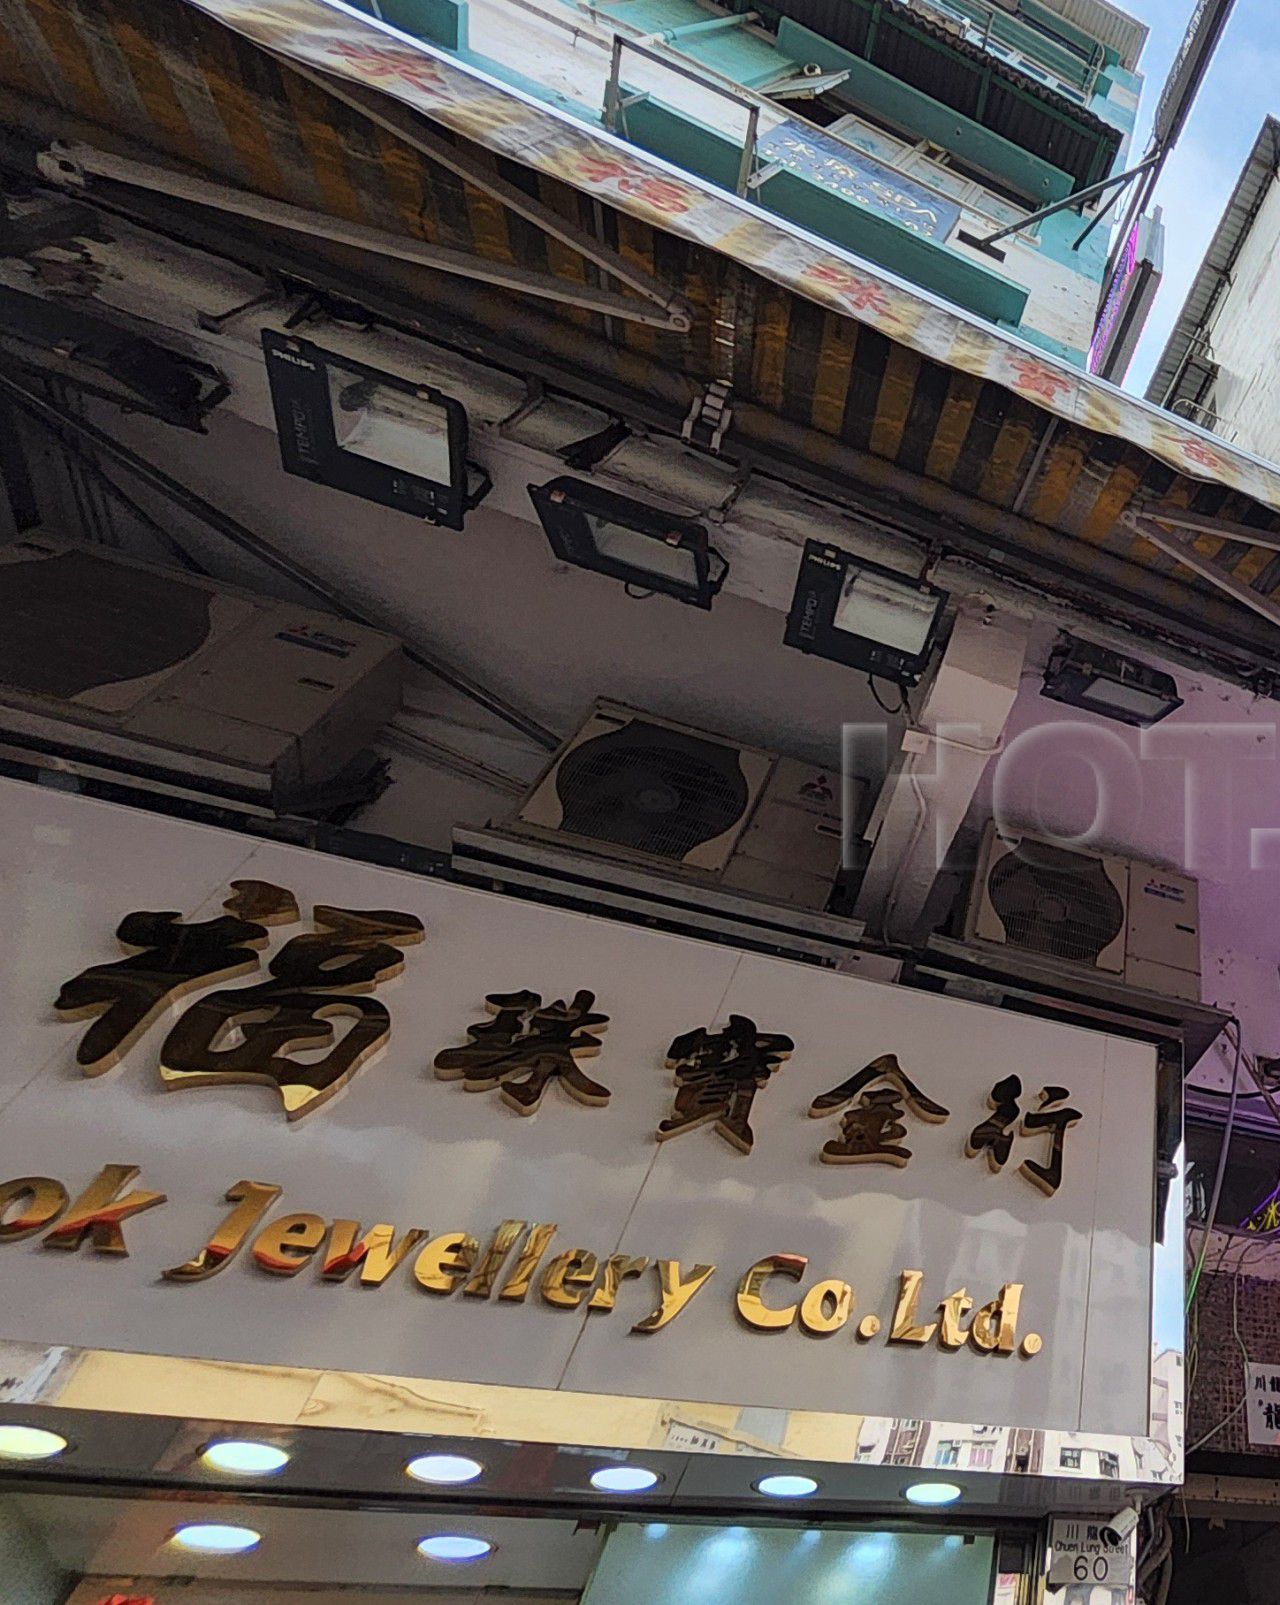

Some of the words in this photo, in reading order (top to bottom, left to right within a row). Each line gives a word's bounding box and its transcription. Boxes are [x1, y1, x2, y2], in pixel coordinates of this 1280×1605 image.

[271, 348, 316, 372] PHILIPS
[807, 553, 842, 572] PHILIPS
[161, 1179, 717, 1334] Jewellery
[1054, 1539, 1079, 1554] Chuen
[1080, 1541, 1101, 1556] Lung
[1073, 1555, 1109, 1581] 60
